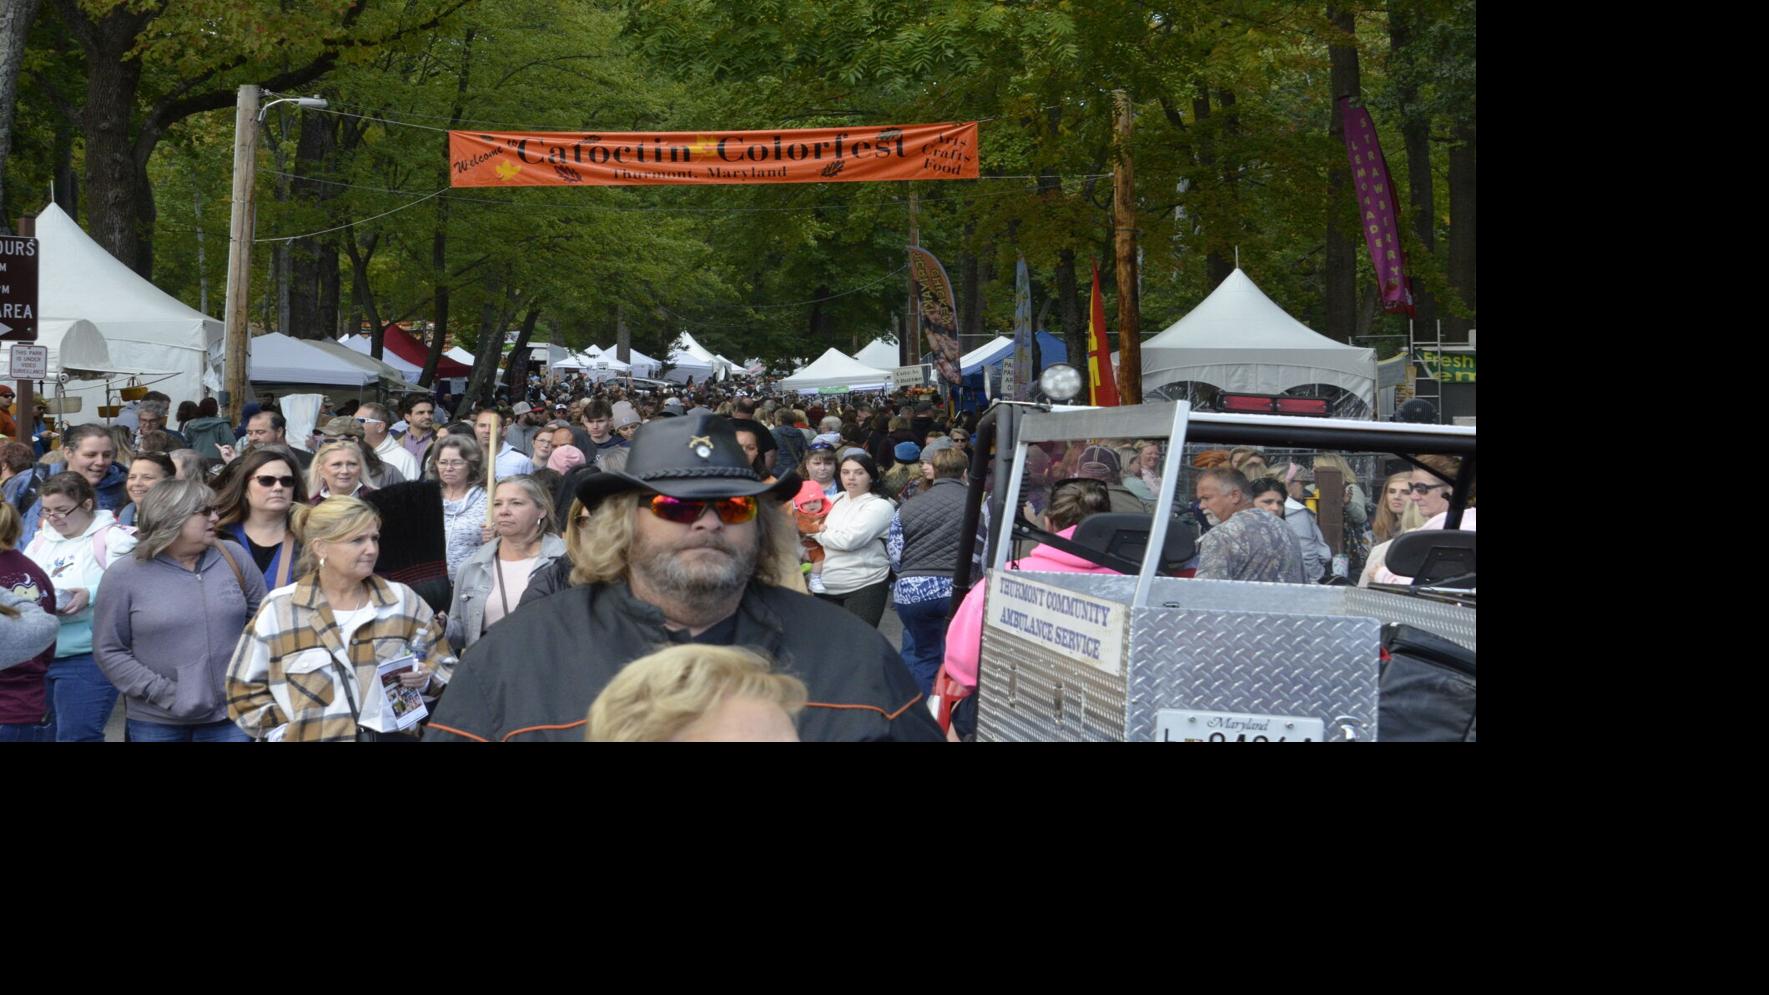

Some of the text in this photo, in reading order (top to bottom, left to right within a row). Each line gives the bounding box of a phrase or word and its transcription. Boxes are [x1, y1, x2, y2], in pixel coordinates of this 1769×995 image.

[517, 131, 906, 164] Catoctin Colorfest
[921, 144, 971, 162] Crafts
[453, 146, 504, 174] Welcome
[924, 157, 962, 175] Food
[706, 165, 788, 181] Maryland
[1351, 140, 1383, 249] LEMONADE
[0, 303, 33, 320] REA
[1423, 351, 1474, 368] Fresh
[1000, 577, 1111, 627] THURMONT COMMUNITY
[1000, 606, 1100, 659] AMBULANCE SERVICE
[1207, 716, 1271, 733] Maryland
